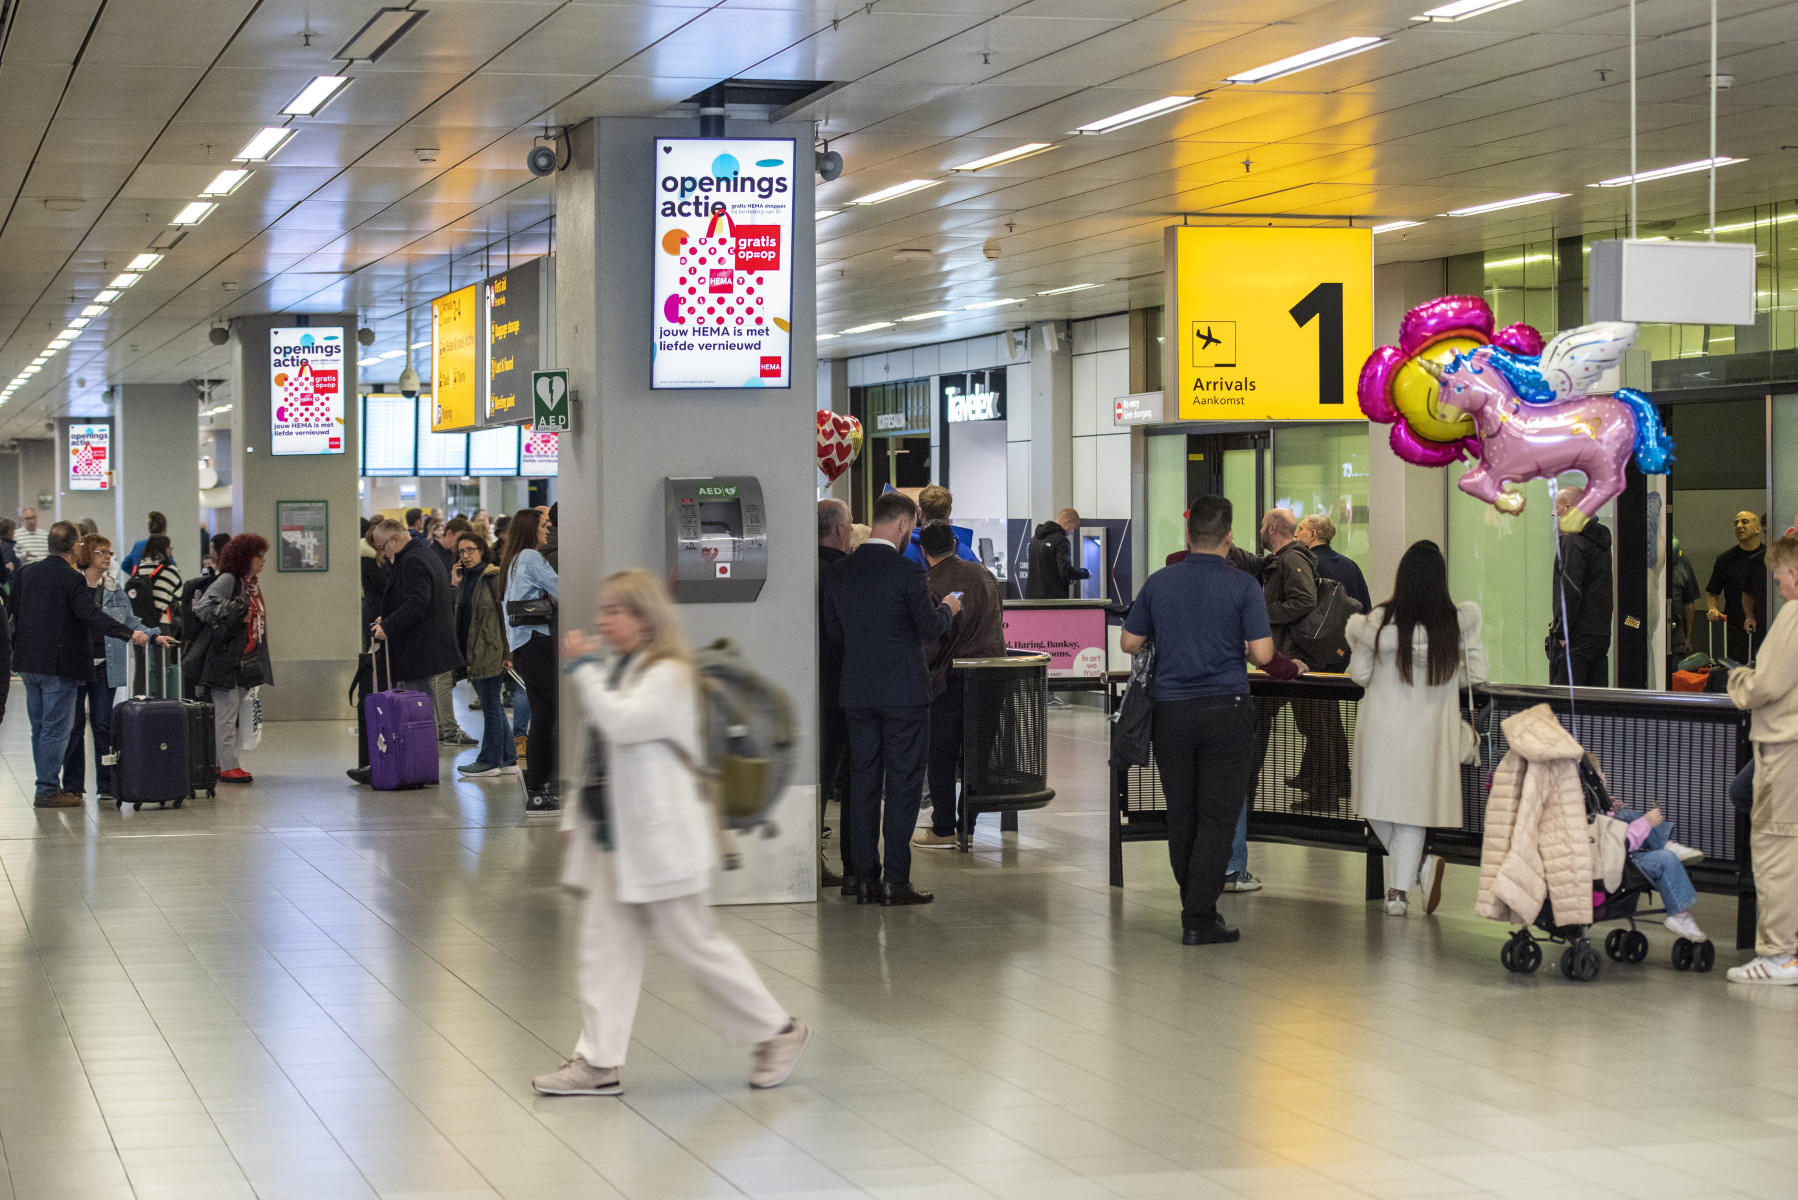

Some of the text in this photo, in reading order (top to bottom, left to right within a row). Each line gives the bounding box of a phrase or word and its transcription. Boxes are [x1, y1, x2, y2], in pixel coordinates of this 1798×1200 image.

[661, 171, 788, 199] openings
[661, 195, 726, 217] actie
[738, 236, 777, 250] gratis
[738, 250, 776, 262] op=op
[709, 277, 733, 286] HEMA
[659, 326, 770, 340] jouw HEMA is met
[659, 340, 762, 351] liefde vernieuwd
[1289, 282, 1344, 405] 1
[273, 343, 341, 357] openings
[273, 356, 308, 367] actie
[760, 363, 781, 371] HEMA
[1193, 377, 1256, 392] Arrivals
[945, 383, 995, 422] Travelex
[1123, 399, 1129, 409] No
[1193, 396, 1245, 406] Aankomst
[539, 415, 566, 426] AED
[698, 487, 722, 495] AED
[1014, 640, 1045, 649] Haring,
[1047, 640, 1080, 650] Banksy,
[1081, 654, 1089, 662] In
